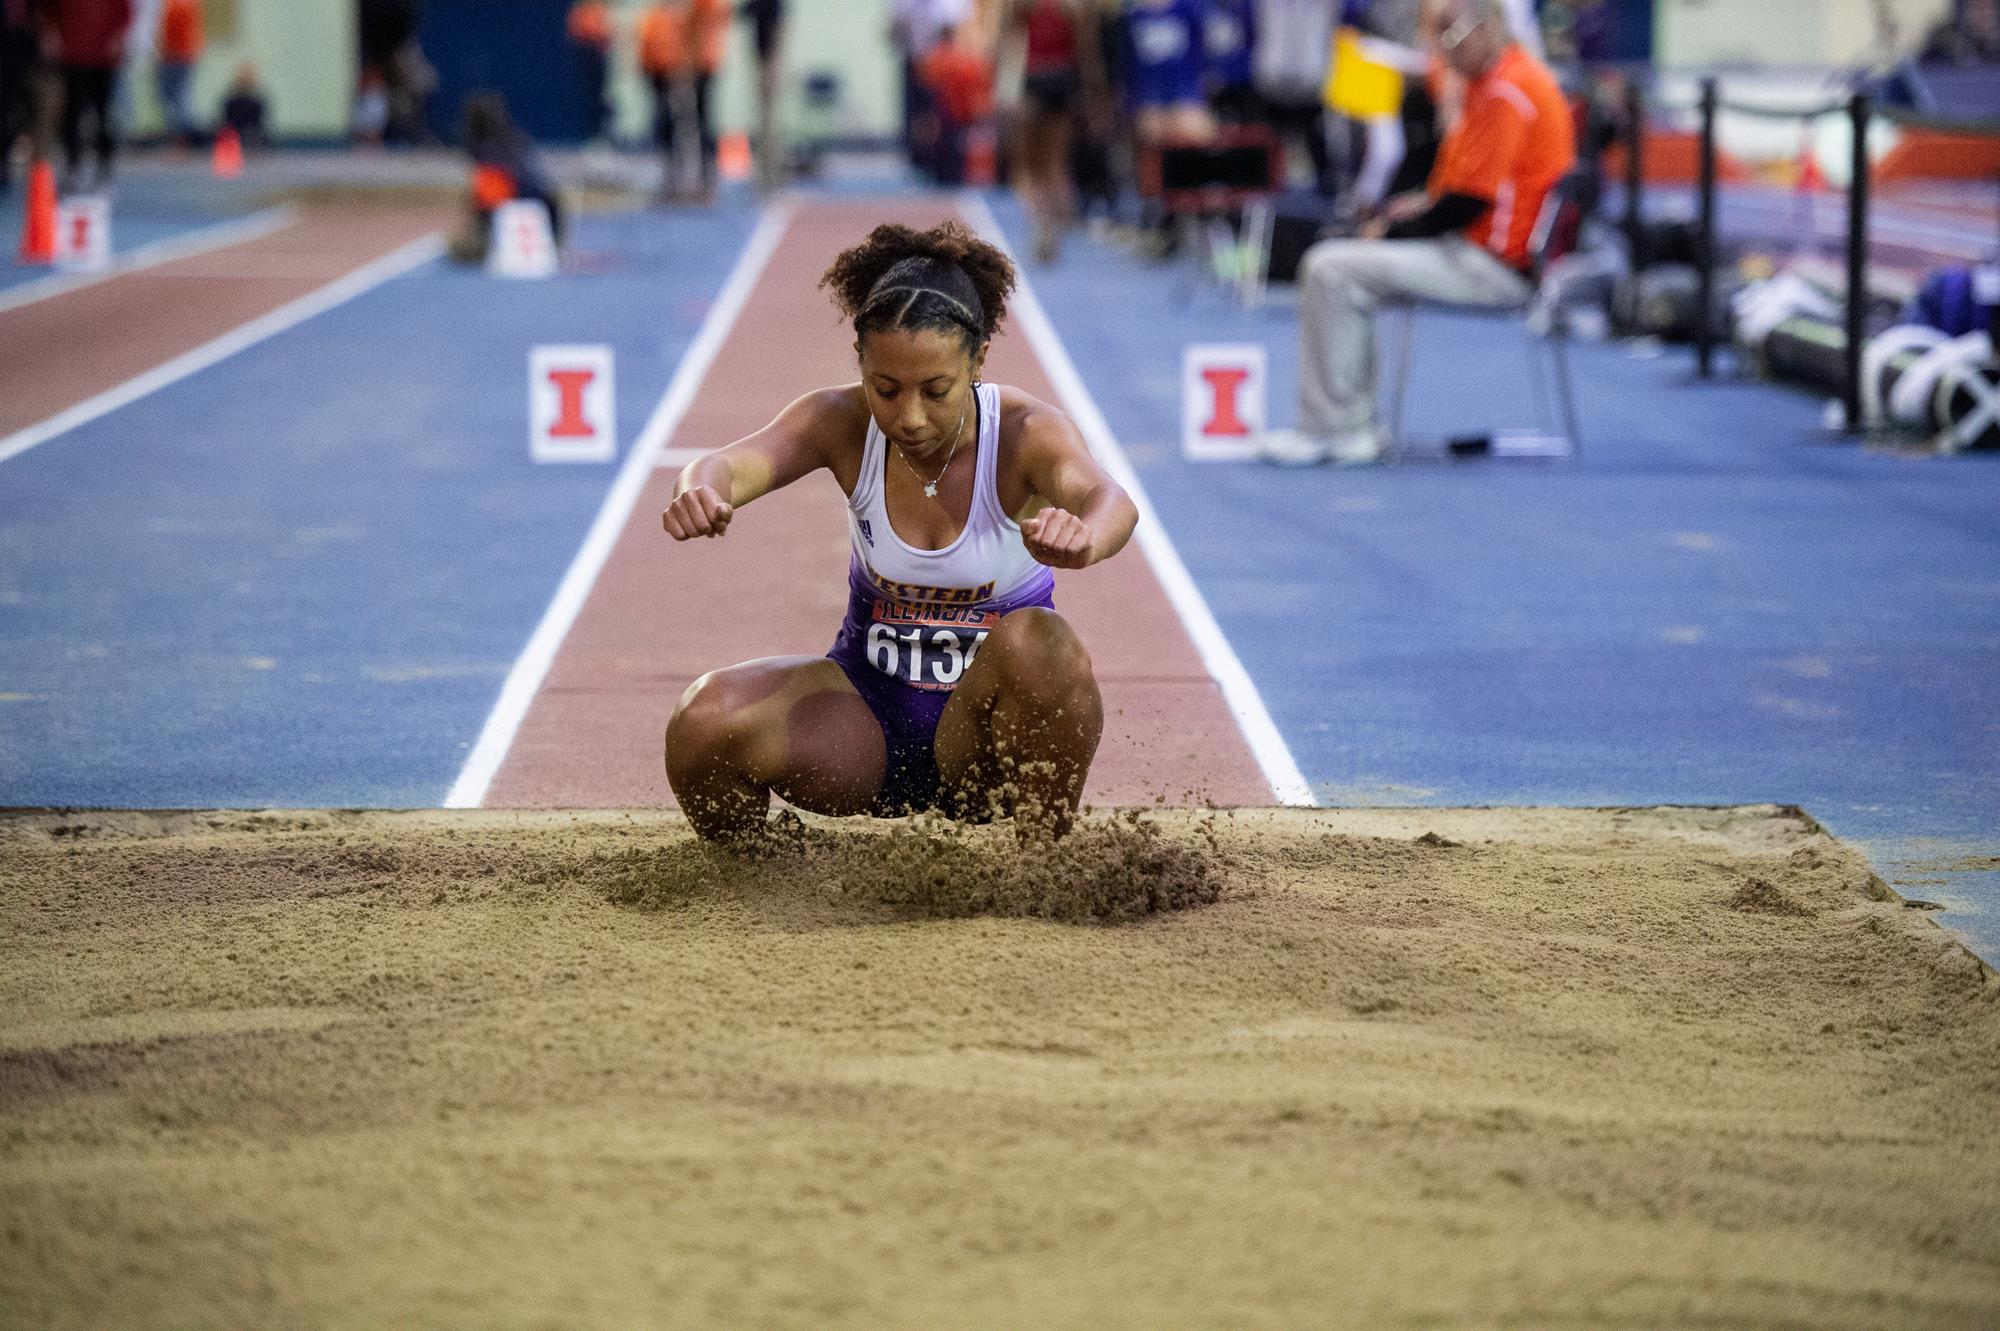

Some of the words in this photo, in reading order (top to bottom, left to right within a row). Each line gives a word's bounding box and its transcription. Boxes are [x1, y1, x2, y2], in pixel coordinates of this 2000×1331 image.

[548, 370, 595, 438] I
[1202, 370, 1248, 437] I
[868, 570, 996, 603] ESTERN
[879, 600, 986, 625] ILLINOIS
